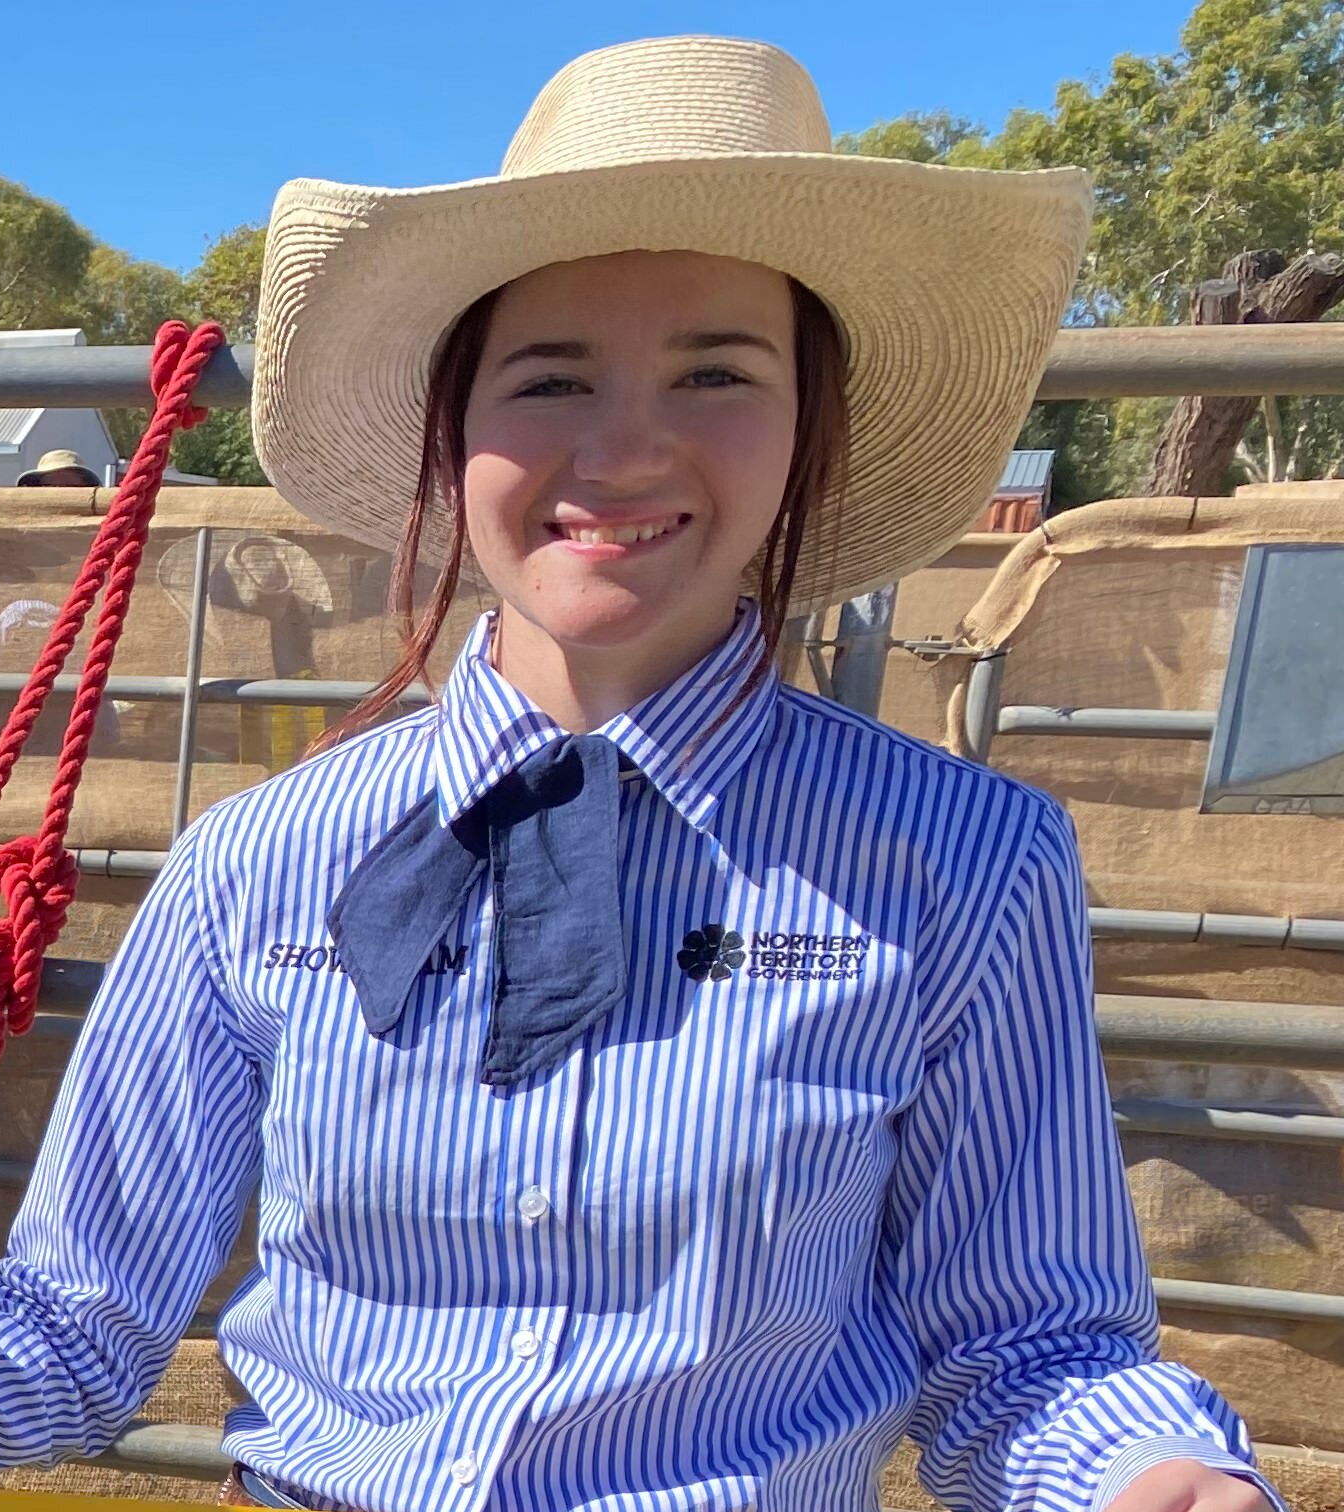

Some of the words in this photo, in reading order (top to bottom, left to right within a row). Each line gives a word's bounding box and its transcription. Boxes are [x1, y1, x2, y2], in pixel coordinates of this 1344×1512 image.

[750, 932, 873, 951] NORTHERN
[749, 950, 867, 969] TERRITORY
[747, 967, 864, 981] GOVERNMENT
